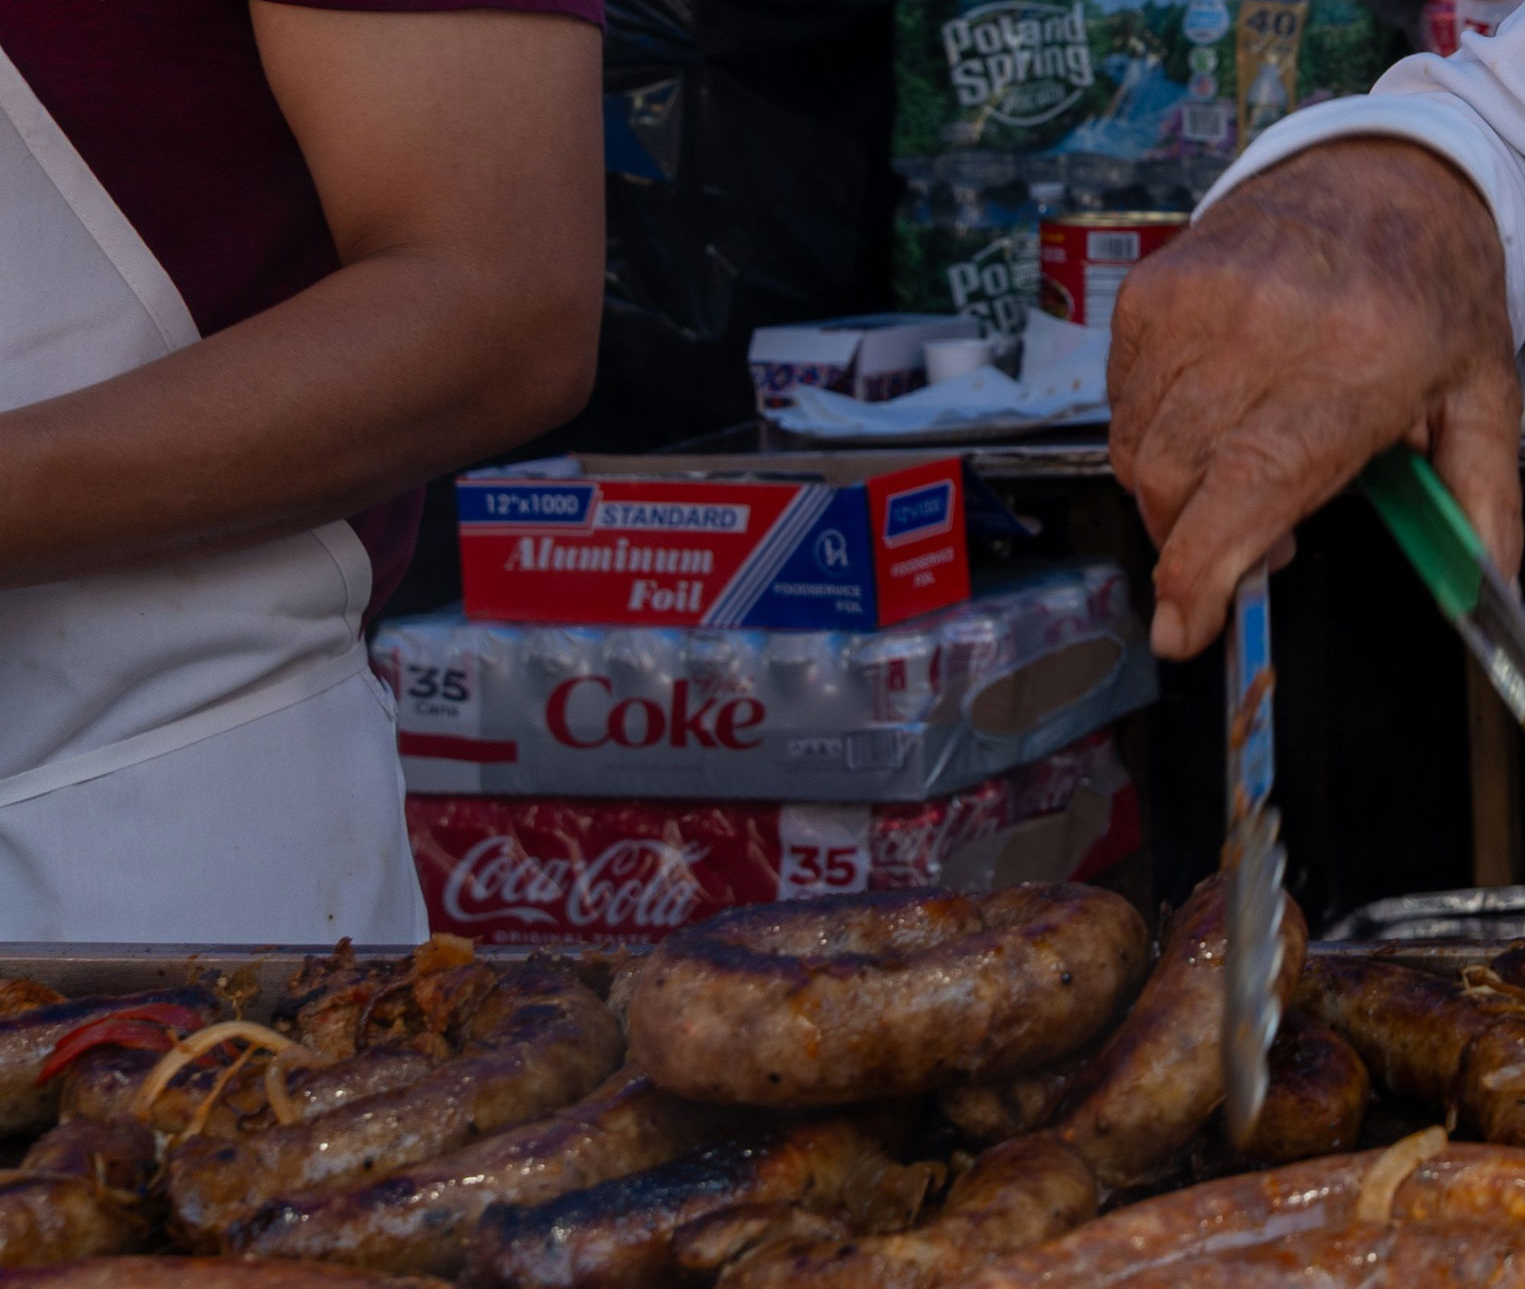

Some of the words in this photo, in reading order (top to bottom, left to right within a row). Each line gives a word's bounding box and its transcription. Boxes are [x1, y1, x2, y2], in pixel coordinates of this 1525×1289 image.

[940, 0, 1090, 65] Poland
[1246, 9, 1297, 38] 40
[951, 42, 1094, 107] Spring
[601, 505, 737, 529] STANDARD
[504, 537, 715, 573] Aluminum
[627, 578, 704, 612] Foil
[773, 582, 862, 599] FOODSERVICE
[835, 599, 863, 614] FOIL
[406, 664, 470, 702] 35
[544, 674, 767, 751] Coke
[787, 844, 857, 886] 35
[493, 929, 584, 945] ORIGINAL
[593, 932, 651, 945] TASTE
